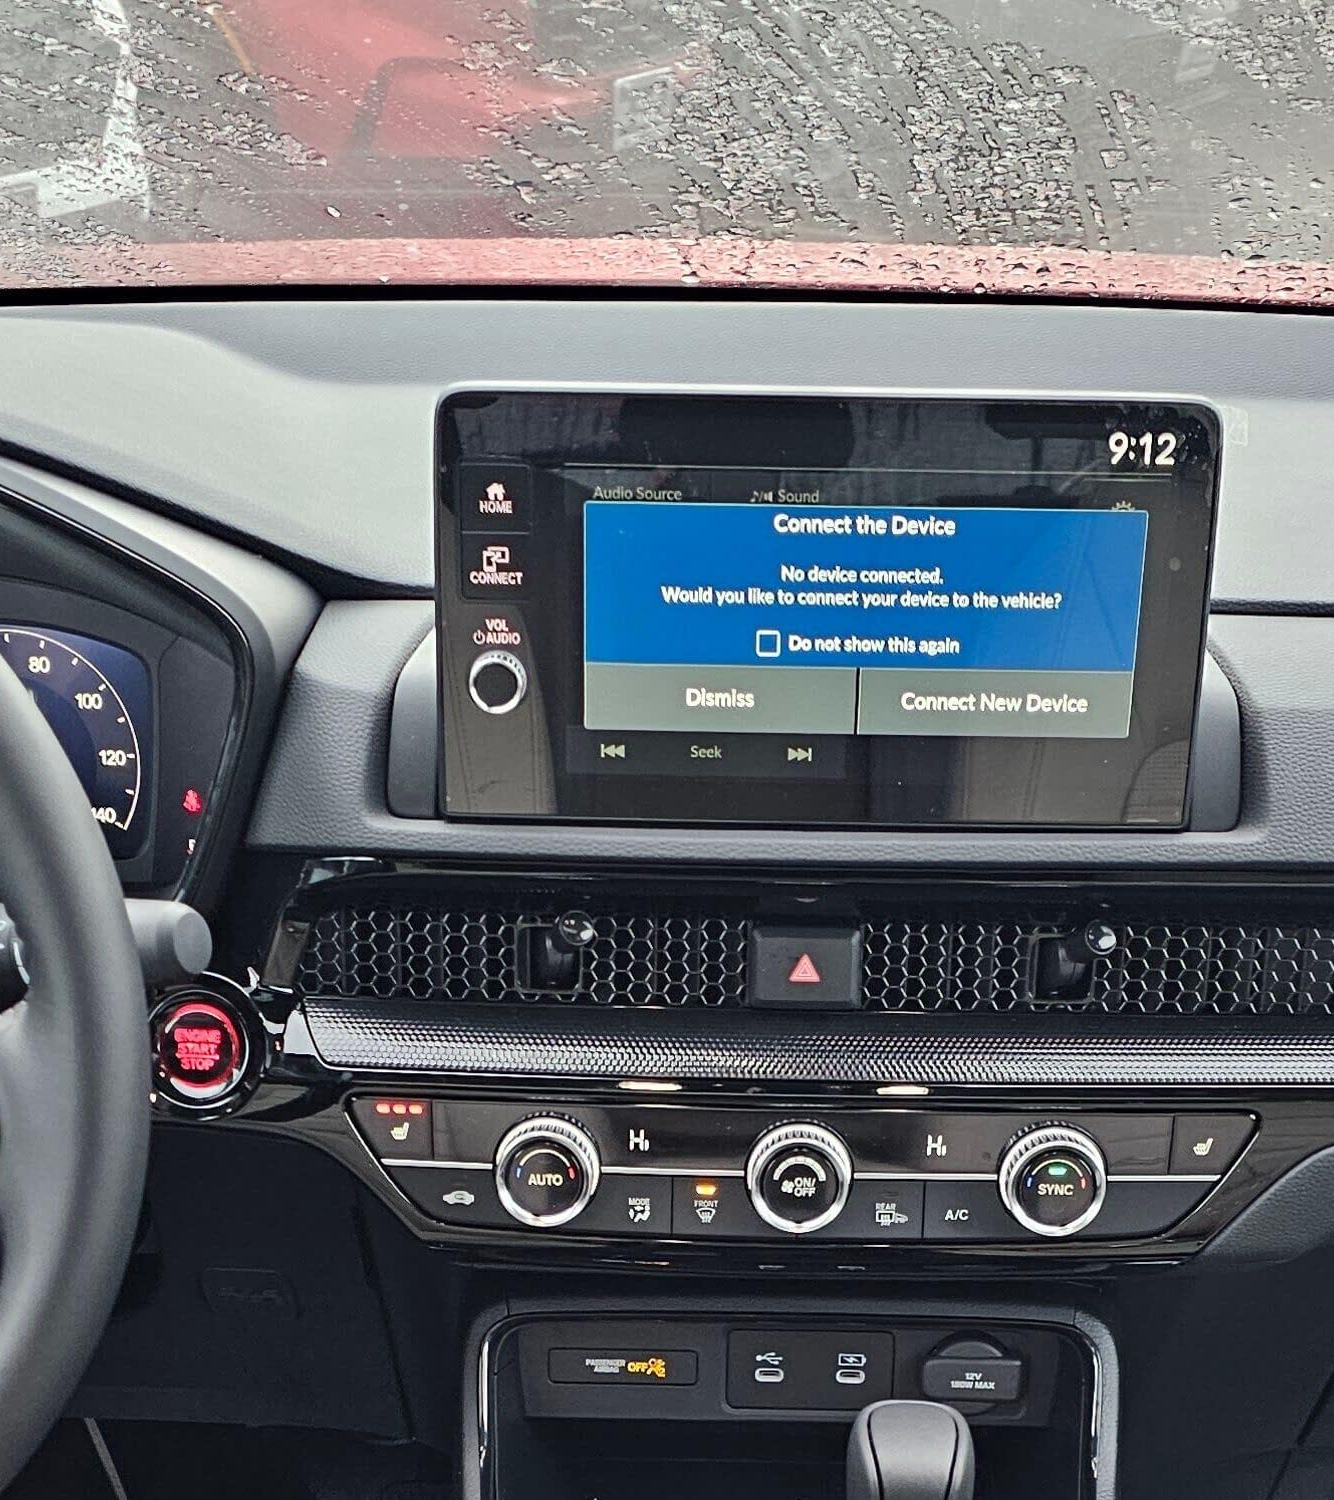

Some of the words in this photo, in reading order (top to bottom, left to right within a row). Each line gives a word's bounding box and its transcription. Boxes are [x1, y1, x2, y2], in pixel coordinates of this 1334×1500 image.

[1109, 433, 1177, 466] 9:12
[593, 486, 634, 501] Audio
[636, 487, 683, 501] Source
[777, 489, 820, 503] Sound
[480, 500, 513, 514] HOME
[773, 514, 853, 536] Connect
[855, 514, 887, 535] the
[890, 515, 956, 537] Device
[470, 571, 524, 586] CONNECT
[780, 564, 805, 582] No
[807, 564, 858, 584] device
[860, 566, 944, 585] connected.
[661, 586, 713, 604] Would
[715, 589, 745, 608] you
[747, 587, 774, 605] like
[777, 589, 794, 606] to
[797, 590, 859, 607] connect
[862, 592, 898, 610] your
[900, 590, 949, 608] device
[953, 592, 970, 608] to
[972, 592, 998, 609] the
[1001, 592, 1063, 610] vehicle?
[485, 618, 509, 632] VOL
[487, 632, 522, 645] AUDIO
[788, 634, 811, 652] Do
[814, 635, 841, 652] not
[844, 635, 885, 653] show
[887, 636, 916, 653] this
[918, 637, 960, 656] again
[28, 656, 51, 673] 80
[74, 692, 103, 710] 100
[685, 687, 755, 709] Dismiss
[900, 691, 977, 712] Connect
[980, 692, 1022, 712] New
[1026, 693, 1088, 714] Device
[98, 749, 127, 766] 120
[690, 744, 722, 760] Seek
[176, 1042, 219, 1054] START
[179, 1059, 215, 1070] STOP
[528, 1173, 564, 1186] AUTO
[794, 1187, 816, 1197] OFF
[1037, 1183, 1074, 1196] SYNC
[694, 1199, 719, 1208] FRONT
[875, 1202, 897, 1210] REAR
[944, 1209, 969, 1221] A/C
[627, 1361, 648, 1373] OFF
[964, 1372, 983, 1380] 12V
[974, 1381, 996, 1390] MAX
